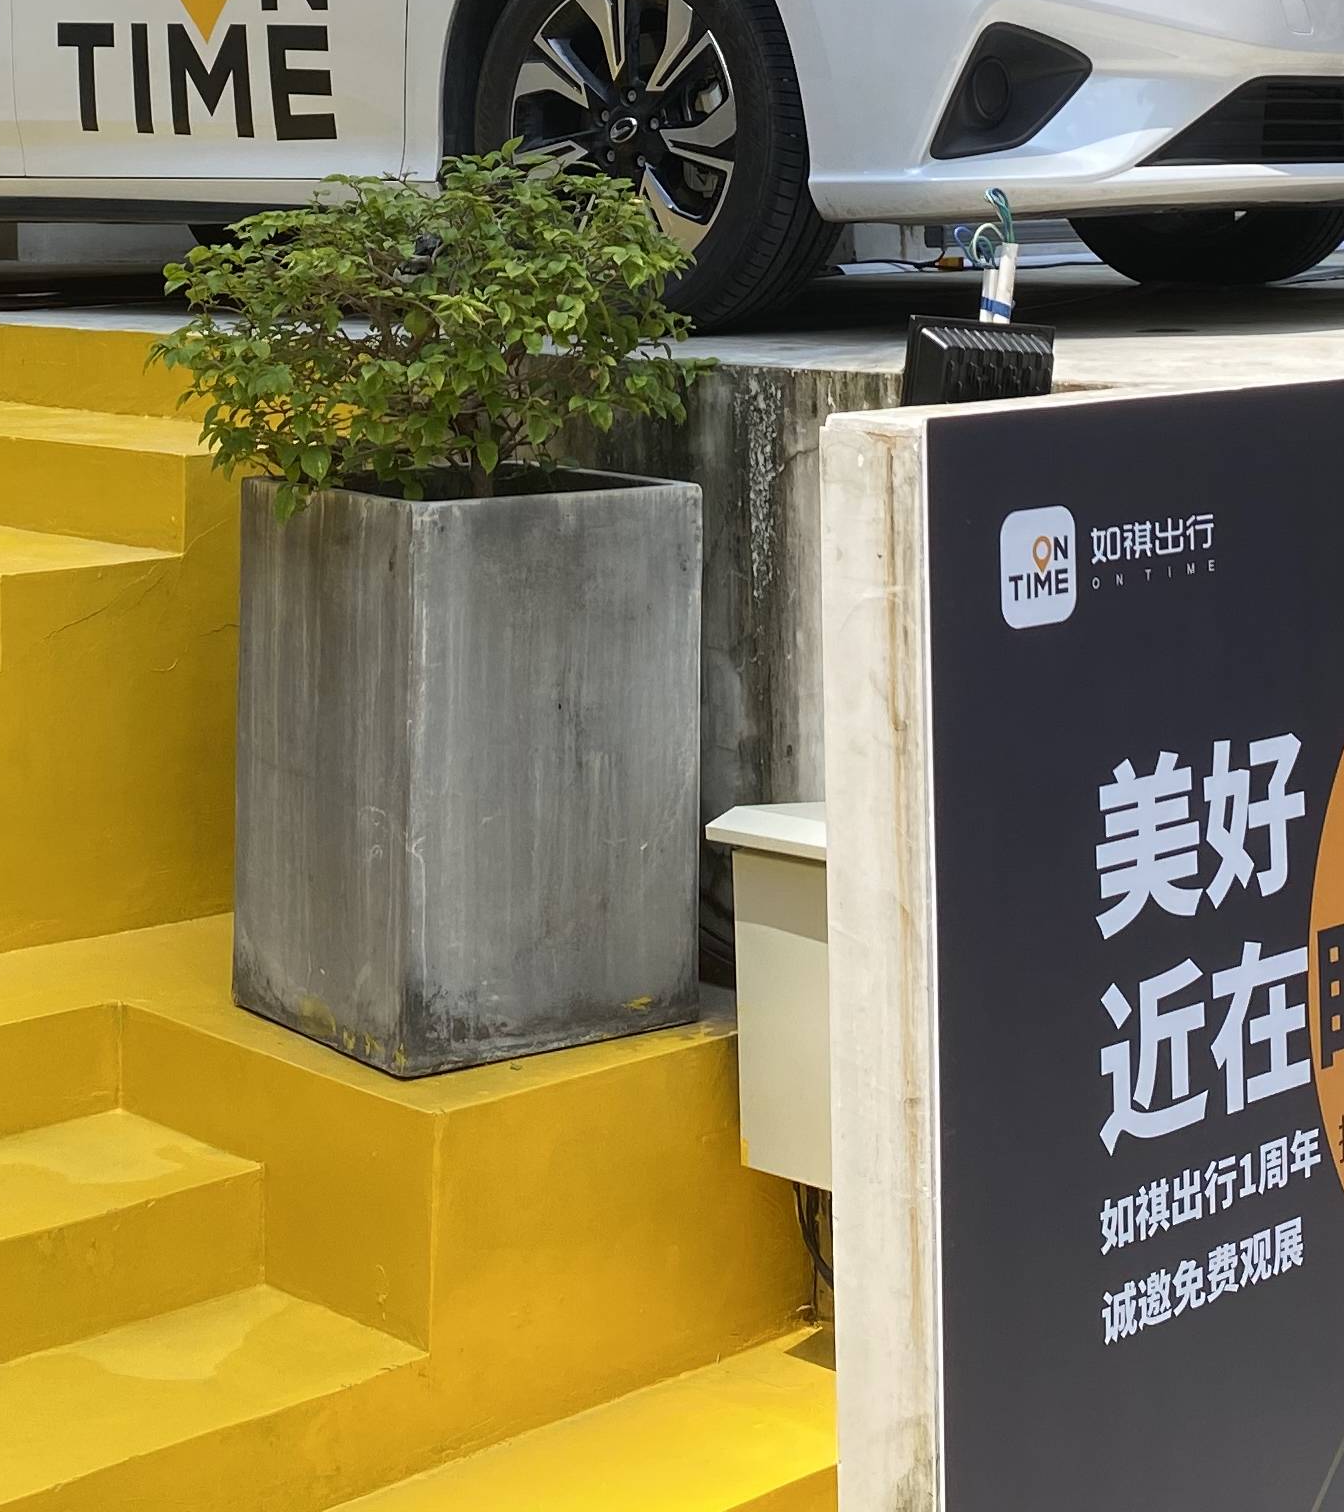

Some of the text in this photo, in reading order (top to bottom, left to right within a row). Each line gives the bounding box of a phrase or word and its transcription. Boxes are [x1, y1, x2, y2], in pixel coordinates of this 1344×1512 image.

[57, 22, 338, 141] TIME
[1008, 568, 1069, 602] TIME
[1032, 535, 1069, 573] ON
[1090, 513, 1215, 565] 如祺出行
[1095, 731, 1306, 940] 美好
[1099, 1127, 1323, 1257] 如祺出行1周年
[1100, 1216, 1305, 1346] 诚邀免费观展
